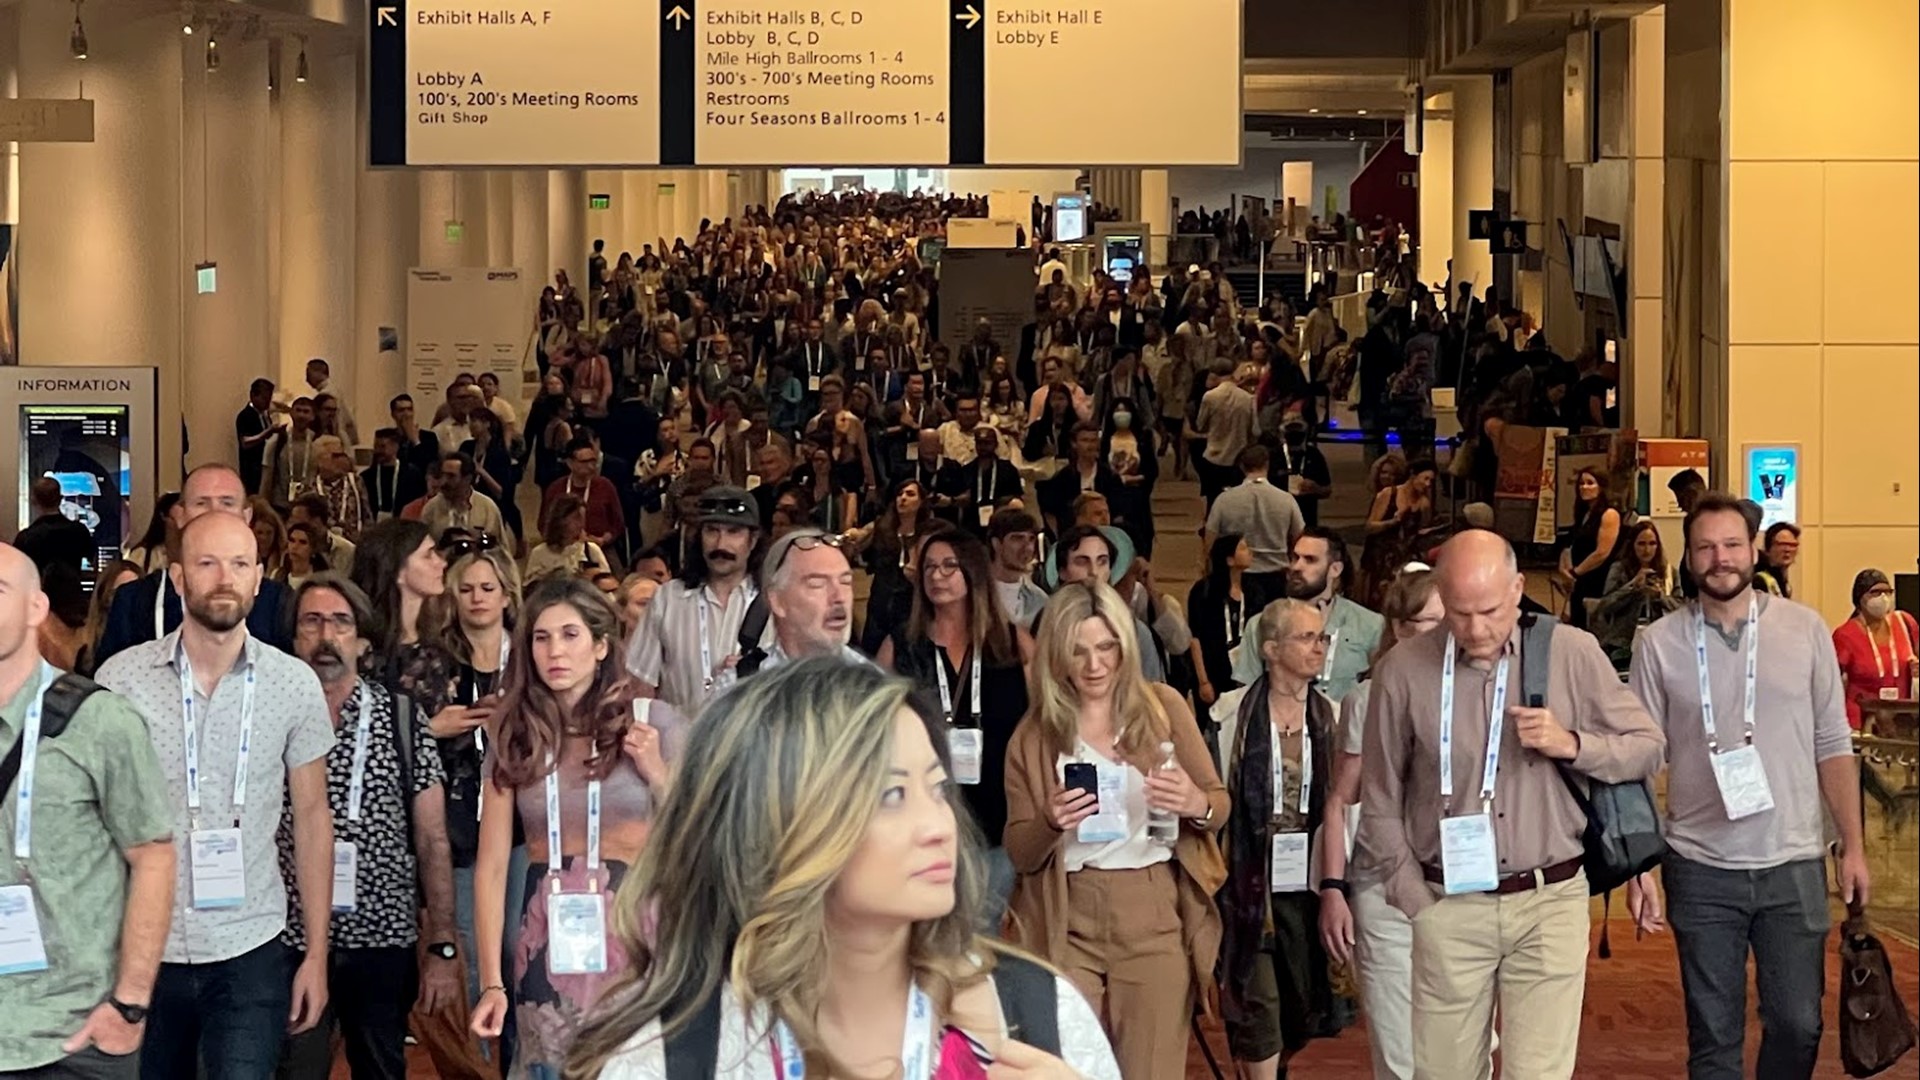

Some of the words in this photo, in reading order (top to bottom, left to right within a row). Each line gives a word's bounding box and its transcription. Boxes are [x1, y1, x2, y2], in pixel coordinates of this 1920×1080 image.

[418, 11, 471, 24] Exhibit
[478, 11, 515, 24] Halls
[521, 11, 536, 26] A,
[544, 11, 550, 24] F
[707, 11, 761, 24] Exhibit
[768, 11, 805, 24] Halls
[811, 11, 824, 26] B,
[831, 11, 844, 26] C,
[851, 11, 862, 24] D
[997, 10, 1051, 23] Exhibit
[1058, 10, 1087, 24] Hall
[1094, 11, 1102, 24] E
[707, 31, 755, 48] Lobby
[768, 31, 781, 46] B,
[787, 31, 801, 46] C,
[808, 31, 819, 44] D
[997, 30, 1045, 47] Lobby
[1051, 31, 1058, 44] E
[707, 52, 739, 65] Mile
[746, 52, 780, 68] High
[788, 51, 862, 64] Ballrooms
[870, 51, 875, 64] 1
[895, 51, 903, 63] 4
[417, 72, 465, 88] Lobby
[471, 72, 483, 85] A
[707, 72, 746, 85] 300's
[763, 72, 802, 85] 700's
[808, 72, 874, 88] Meeting
[881, 72, 933, 85] Rooms
[419, 92, 460, 107] 100's,
[467, 92, 507, 105] 200's
[513, 92, 579, 109] Meeting
[585, 92, 638, 105] Rooms
[707, 92, 789, 105] Restrooms
[419, 112, 445, 123] Gift
[453, 112, 488, 124] Shop
[707, 112, 744, 125] Four
[751, 112, 816, 125] Seasons
[822, 111, 906, 125] Ballrooms
[914, 112, 920, 125] 1
[936, 112, 945, 123] 4
[18, 379, 130, 391] INFORMATION
